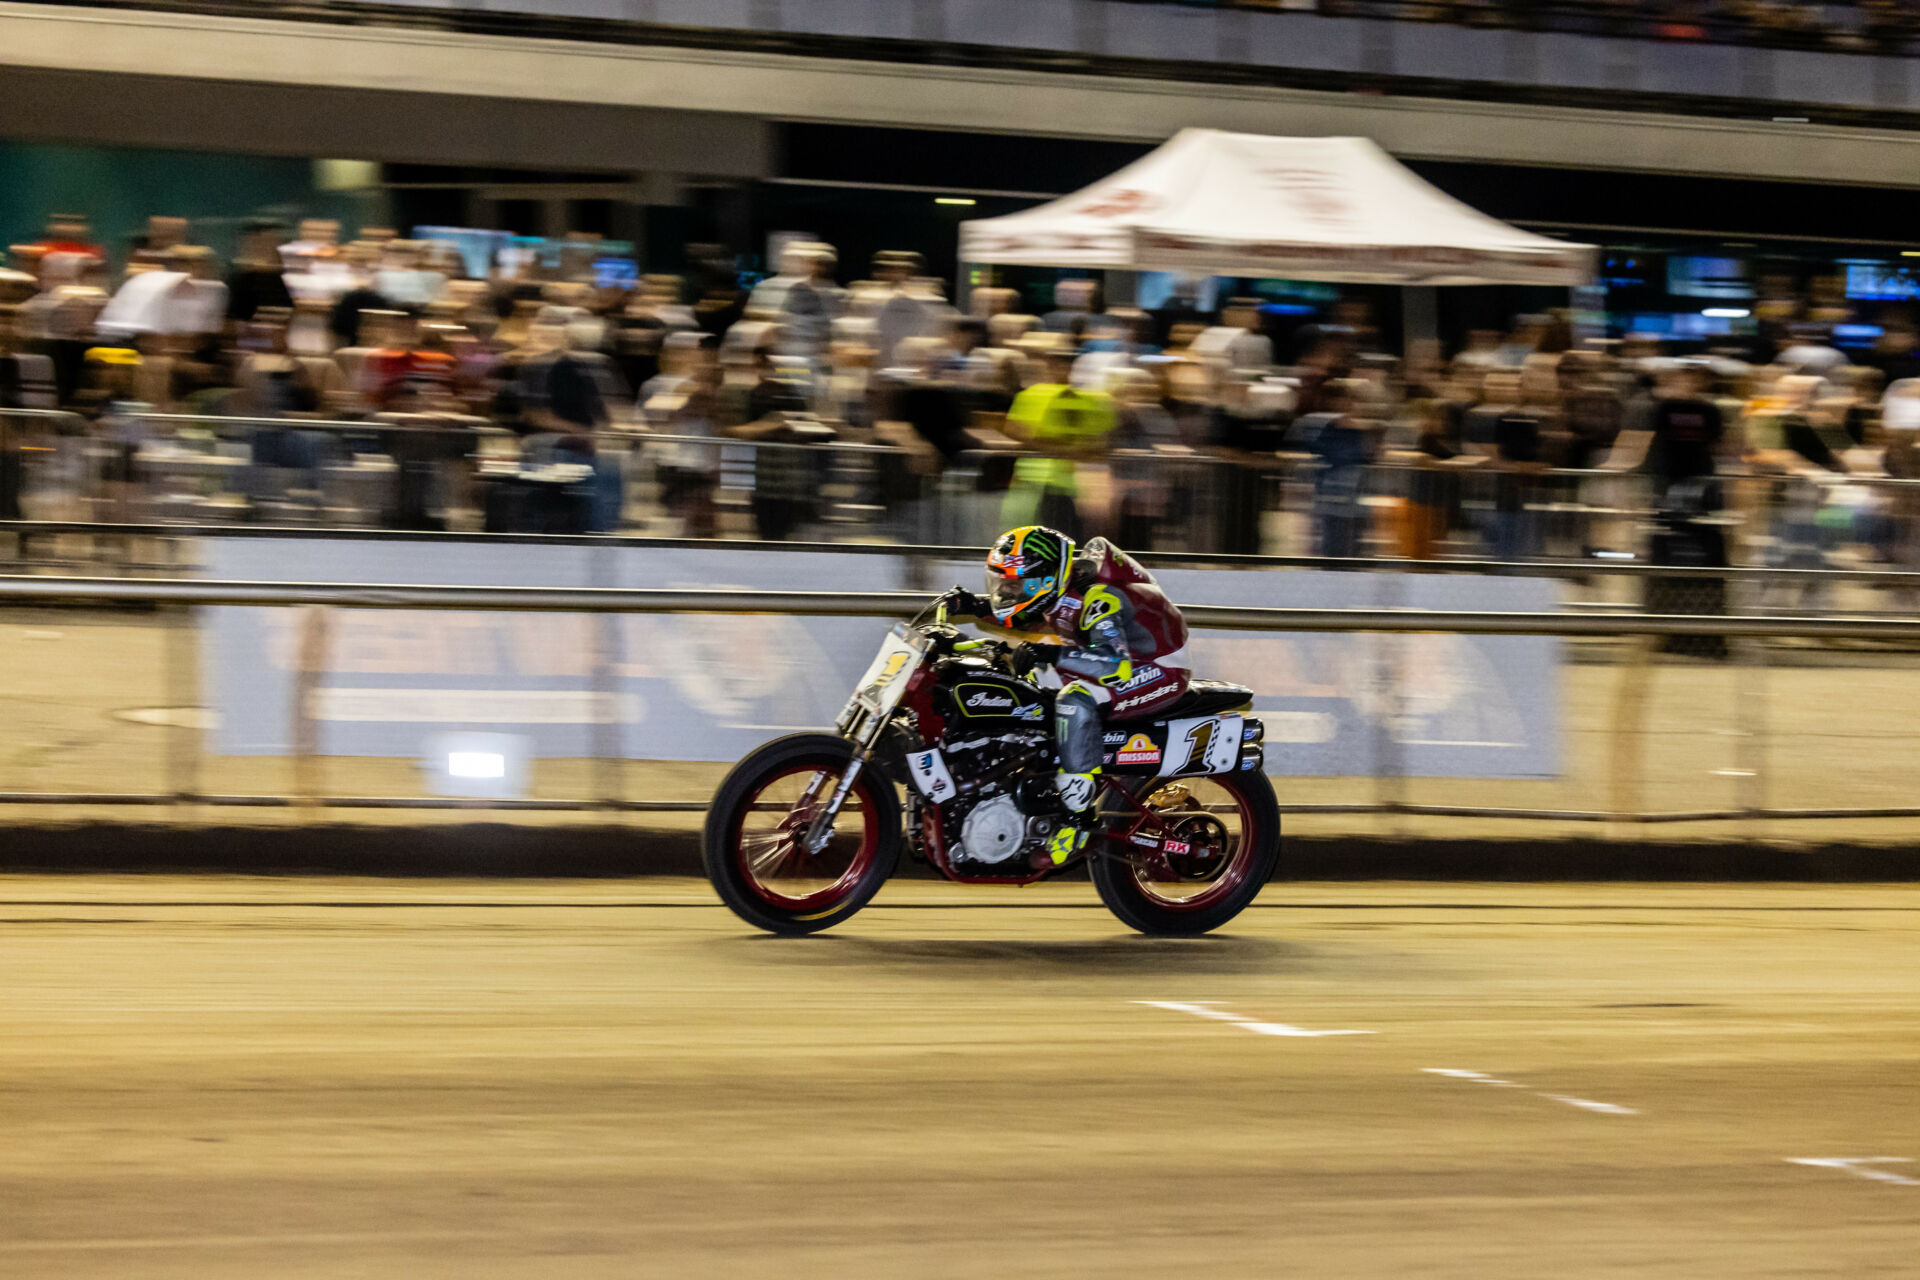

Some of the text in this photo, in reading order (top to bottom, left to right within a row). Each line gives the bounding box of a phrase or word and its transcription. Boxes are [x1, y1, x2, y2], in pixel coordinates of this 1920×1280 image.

[966, 692, 1013, 707] Indian
[1169, 718, 1220, 777] 1
[1165, 841, 1188, 854] RK
